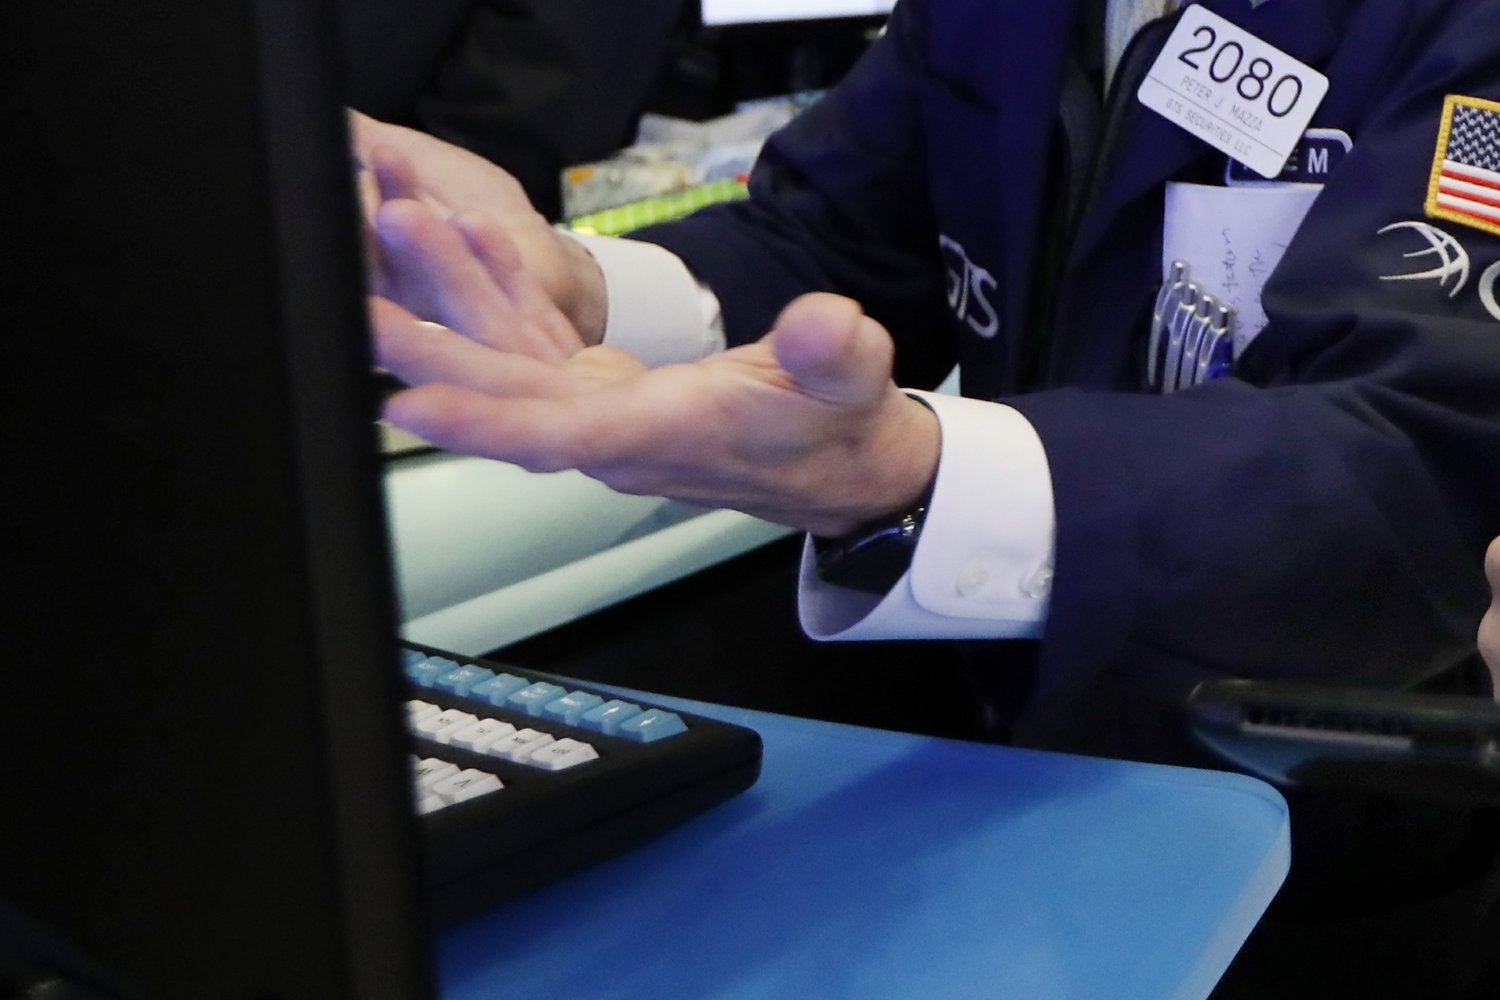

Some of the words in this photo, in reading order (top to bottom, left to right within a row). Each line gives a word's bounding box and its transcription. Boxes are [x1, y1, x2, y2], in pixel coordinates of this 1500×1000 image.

[1177, 25, 1303, 118] 2080
[1180, 75, 1213, 100] PETER
[1184, 109, 1232, 145] SECURITIES
